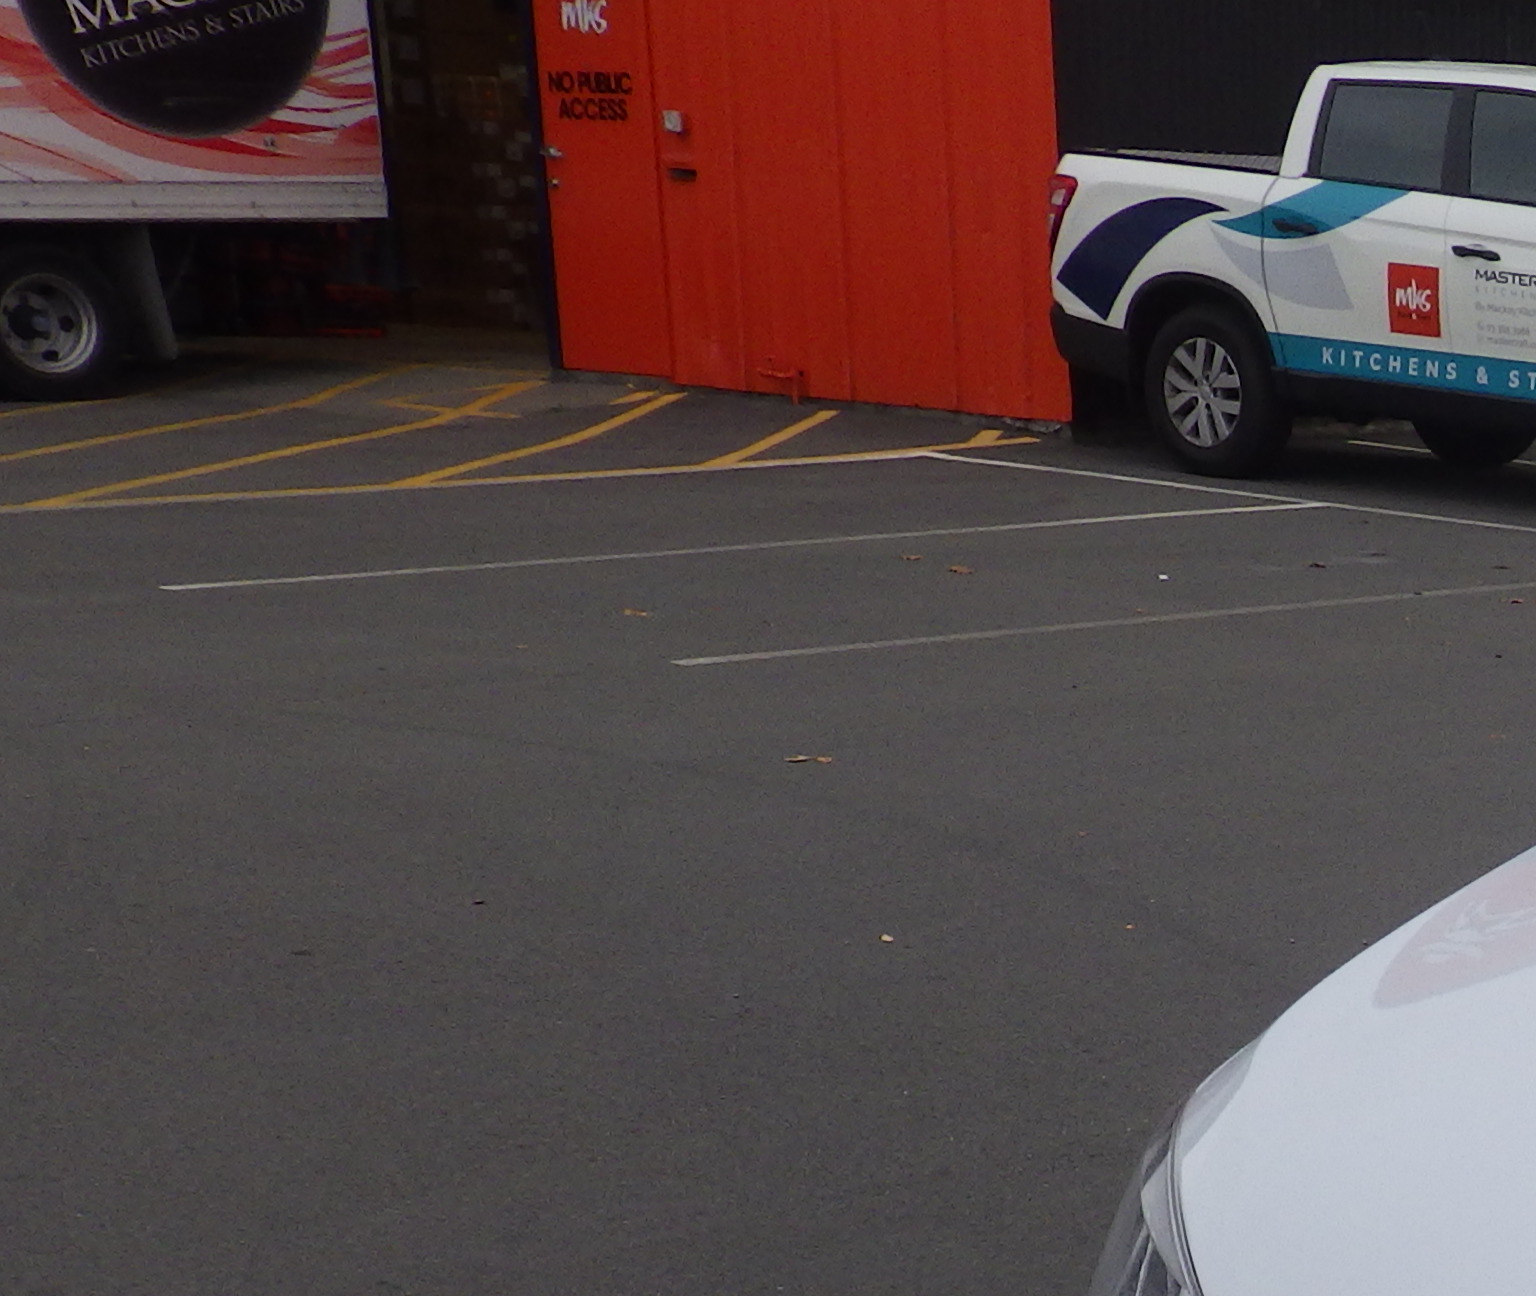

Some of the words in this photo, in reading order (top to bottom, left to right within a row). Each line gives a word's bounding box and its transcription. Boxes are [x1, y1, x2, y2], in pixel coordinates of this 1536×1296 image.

[81, 21, 199, 68] KITCHENS
[205, 14, 224, 35] &
[229, 0, 304, 28] STAIRS
[547, 71, 574, 93] NO
[576, 71, 632, 95] PUBLIC
[560, 97, 628, 121] ACCESS
[1322, 346, 1457, 379] KITCHENS
[1476, 366, 1488, 385] &
